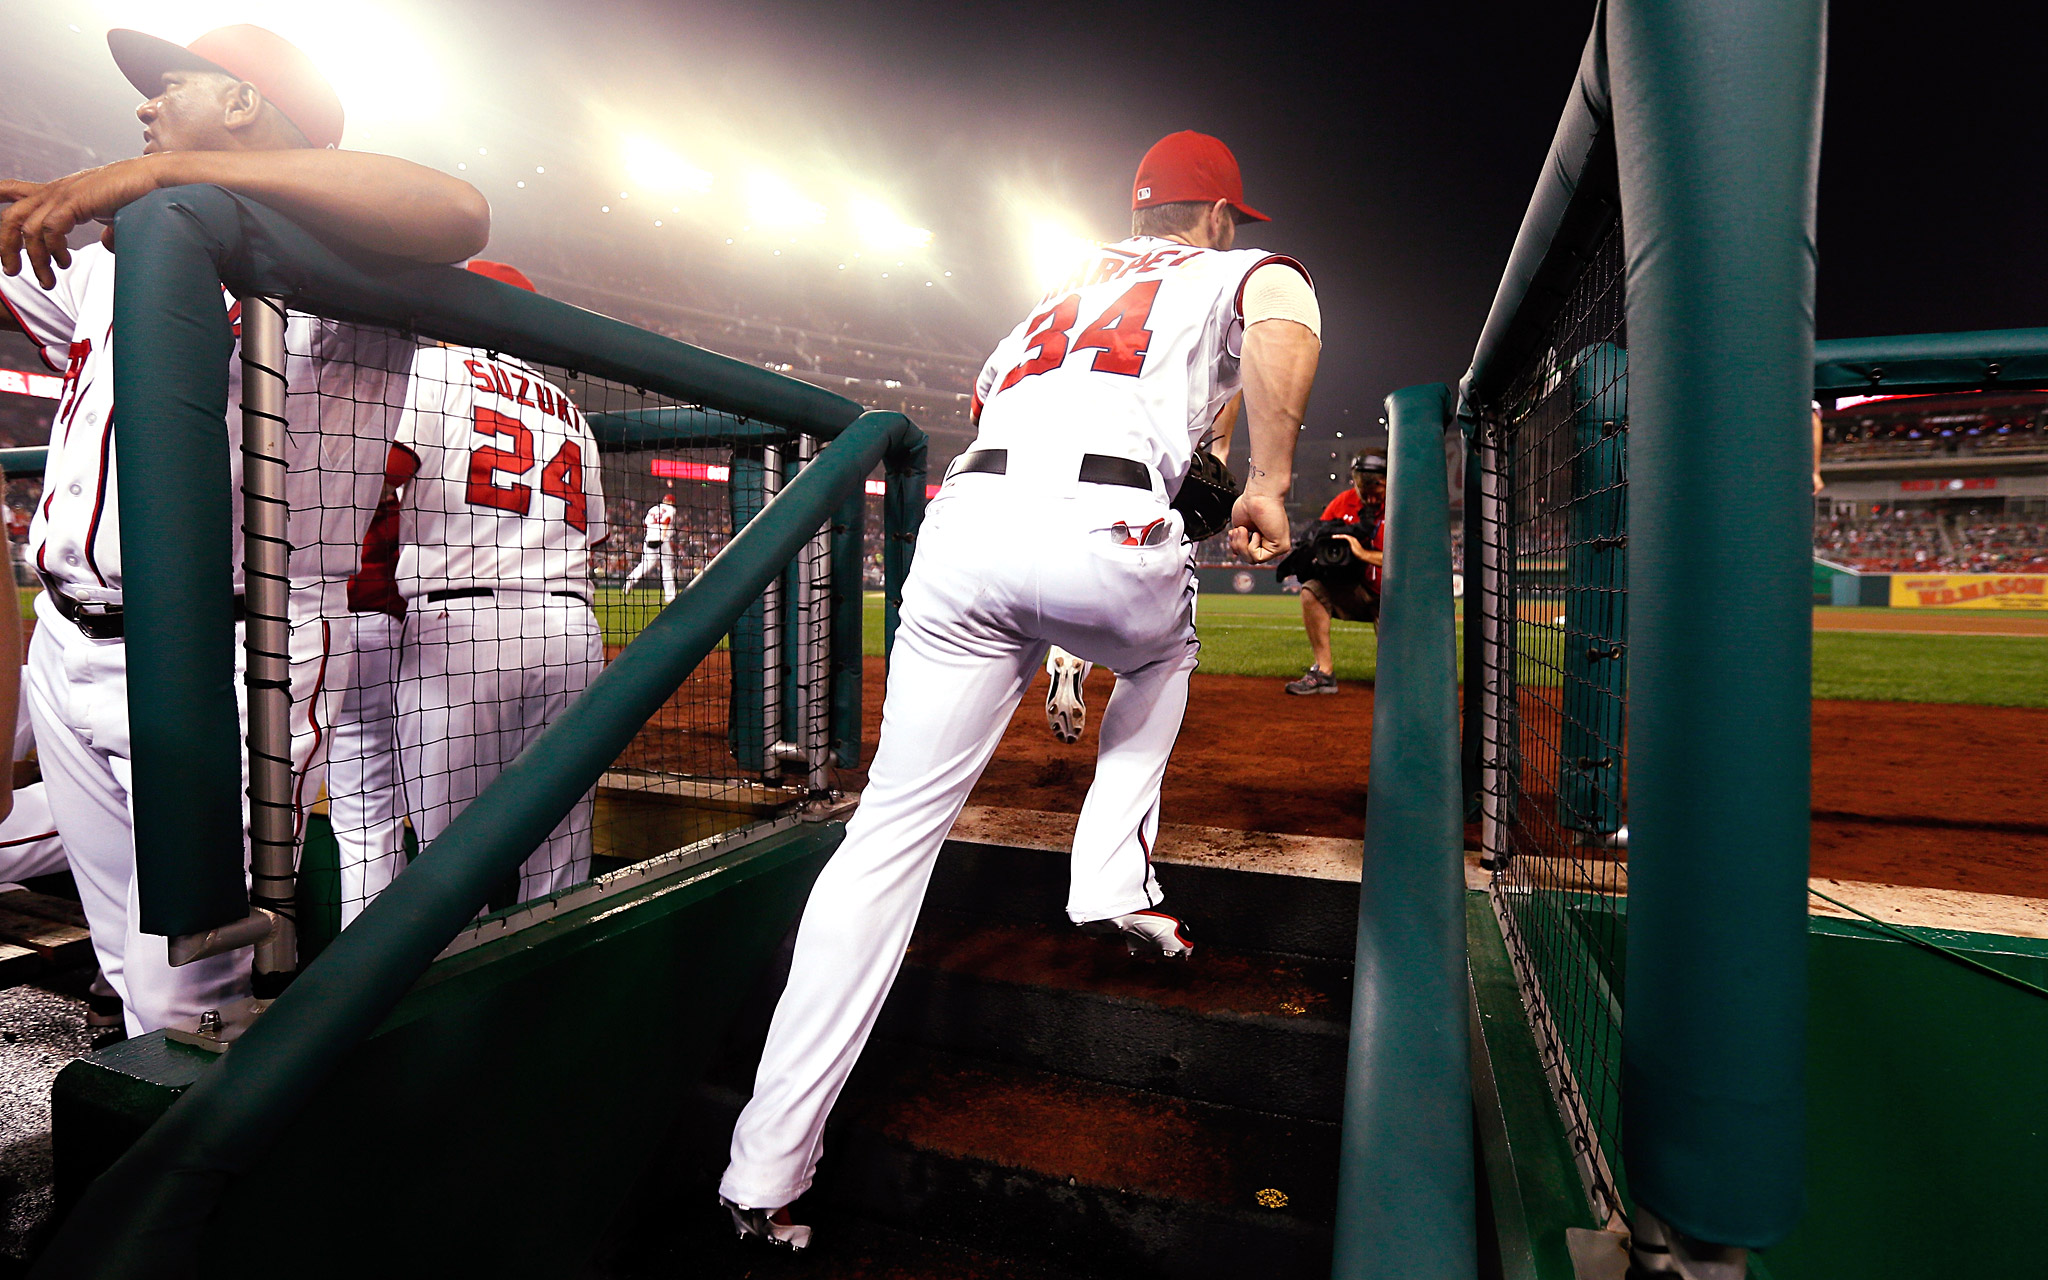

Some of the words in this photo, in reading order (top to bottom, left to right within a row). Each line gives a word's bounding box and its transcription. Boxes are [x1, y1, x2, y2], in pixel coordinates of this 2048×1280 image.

[997, 278, 1164, 396] 34
[463, 359, 580, 434] SUZUKI
[464, 405, 587, 536] 24
